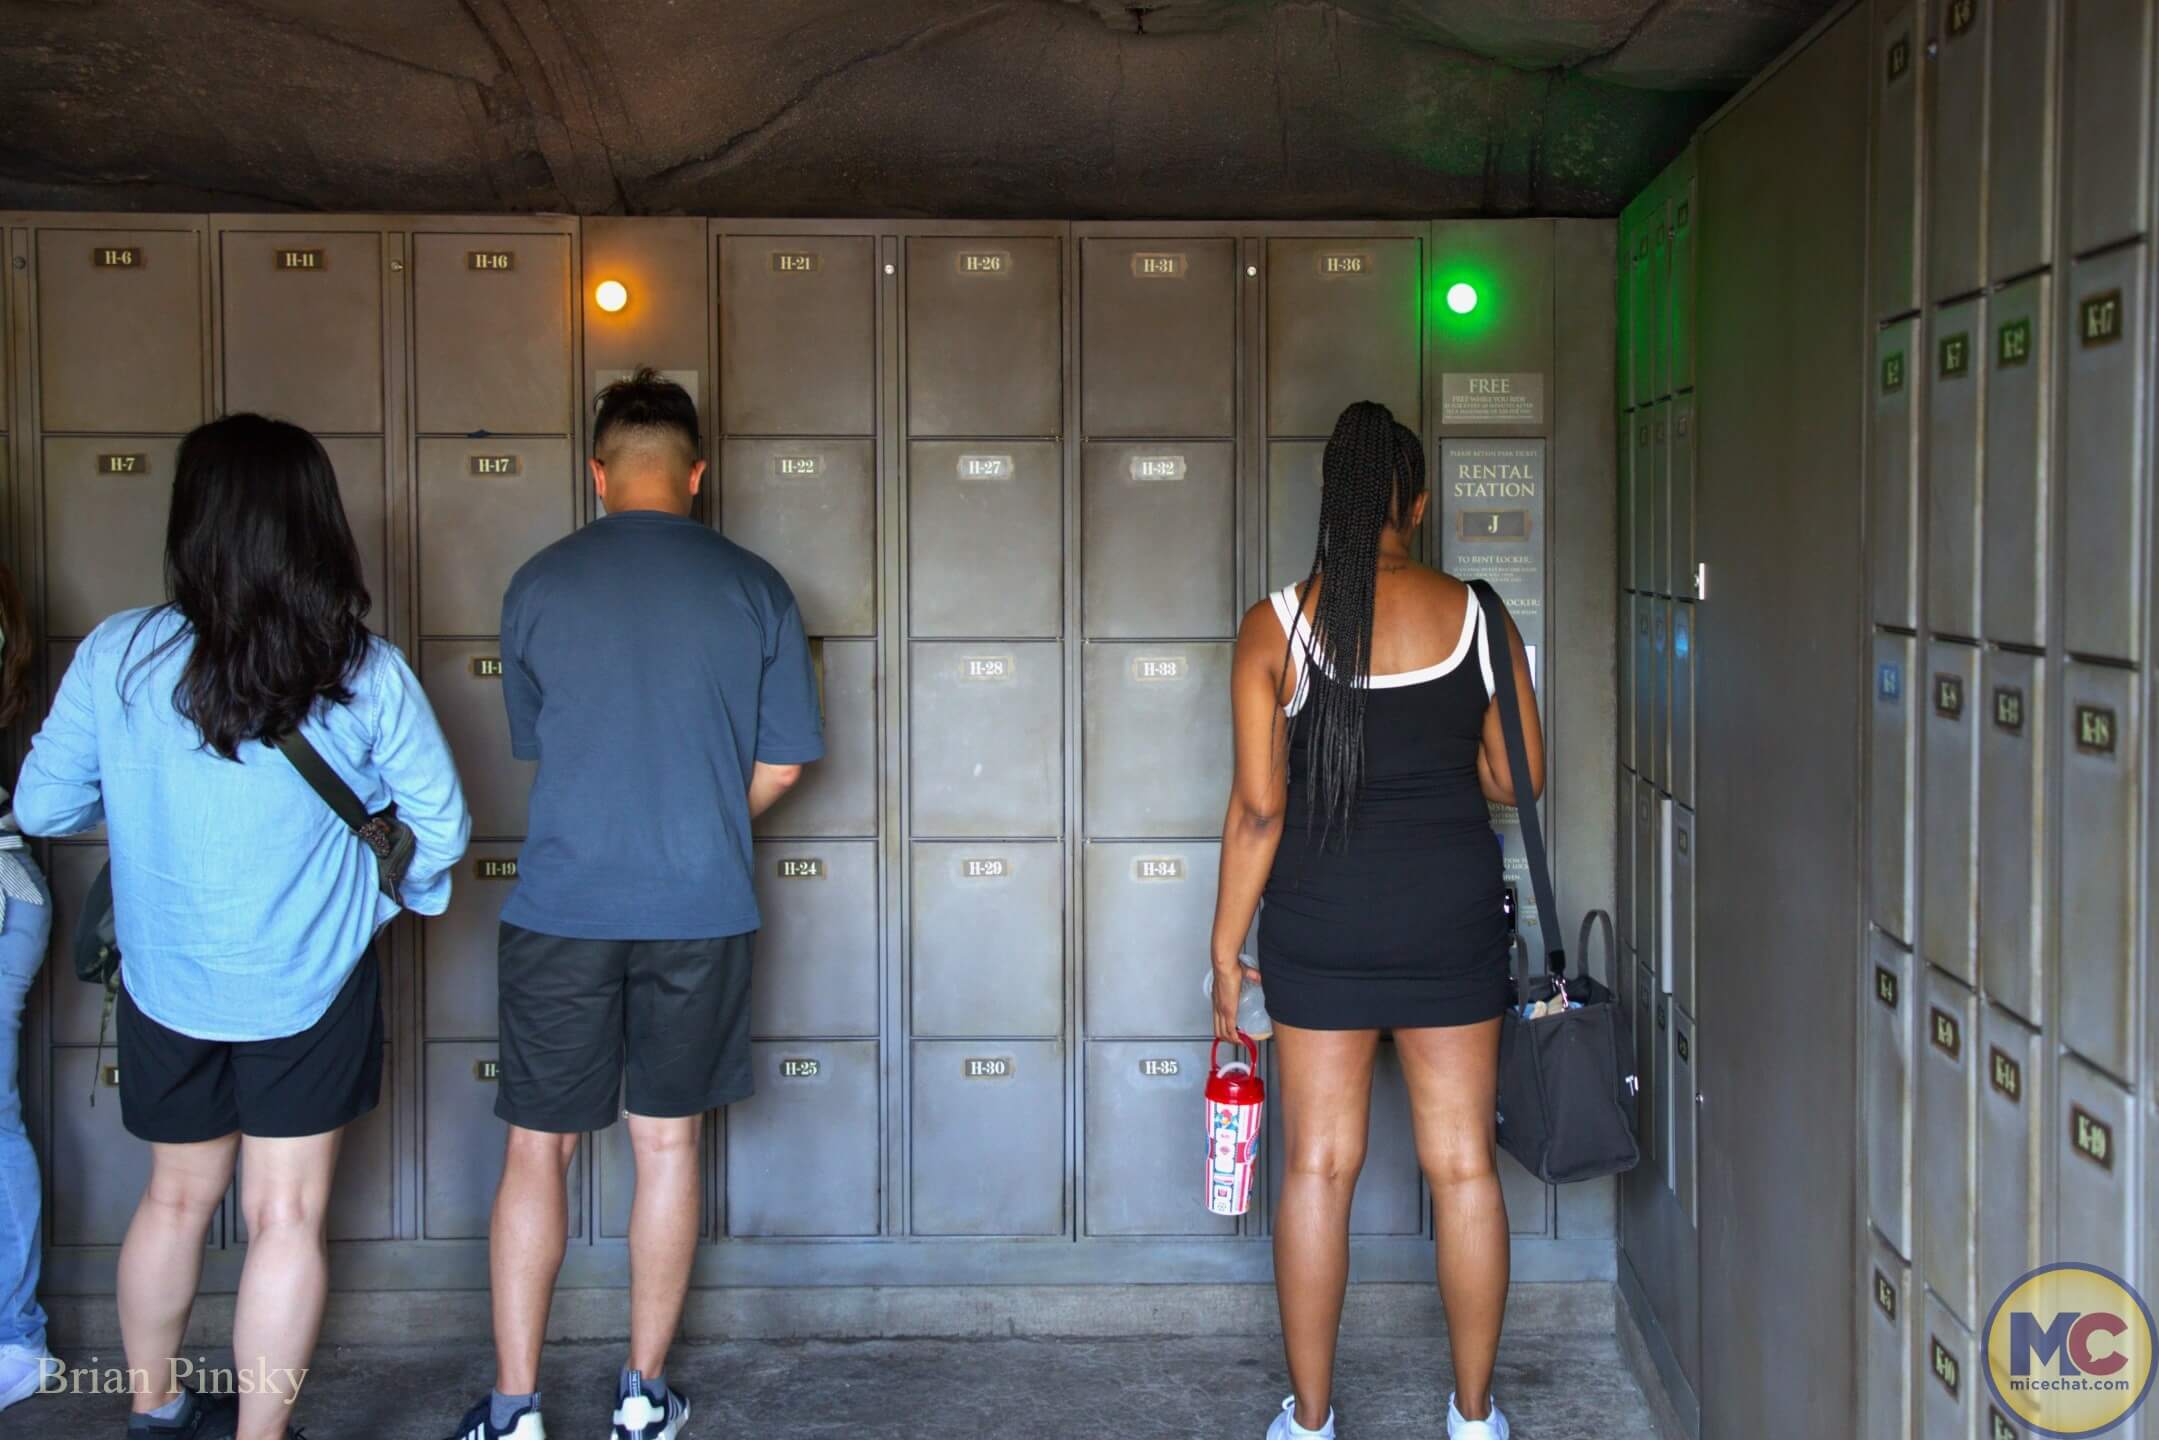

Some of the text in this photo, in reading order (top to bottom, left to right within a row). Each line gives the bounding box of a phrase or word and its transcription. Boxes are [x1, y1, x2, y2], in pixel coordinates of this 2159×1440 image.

[105, 250, 132, 265] H-6
[286, 252, 314, 267] H-11
[477, 254, 508, 268] H-16
[781, 256, 810, 270] H-21
[968, 256, 1000, 270] H-26
[1328, 257, 1361, 272] H-36
[1144, 258, 1173, 273] H-31
[1468, 378, 1510, 394] FREE
[111, 457, 135, 471] H-7
[479, 458, 509, 473] H-17
[783, 459, 814, 473] H-22
[969, 460, 1001, 475] H-27
[1142, 461, 1175, 476] H-32
[1459, 464, 1533, 479] RENTAL
[1454, 482, 1535, 497] STATION
[1487, 514, 1499, 534] J
[1458, 555, 1470, 564] TO
[482, 660, 503, 674] H-1
[970, 661, 1003, 676] H-28
[1144, 662, 1177, 676] H-33
[487, 862, 517, 875] H-19
[785, 862, 817, 875] H-24
[969, 861, 1002, 875] H-29
[1142, 861, 1176, 876] H-34
[786, 1062, 817, 1075] H-25
[972, 1061, 1005, 1075] H-30
[1145, 1061, 1178, 1075] H-35
